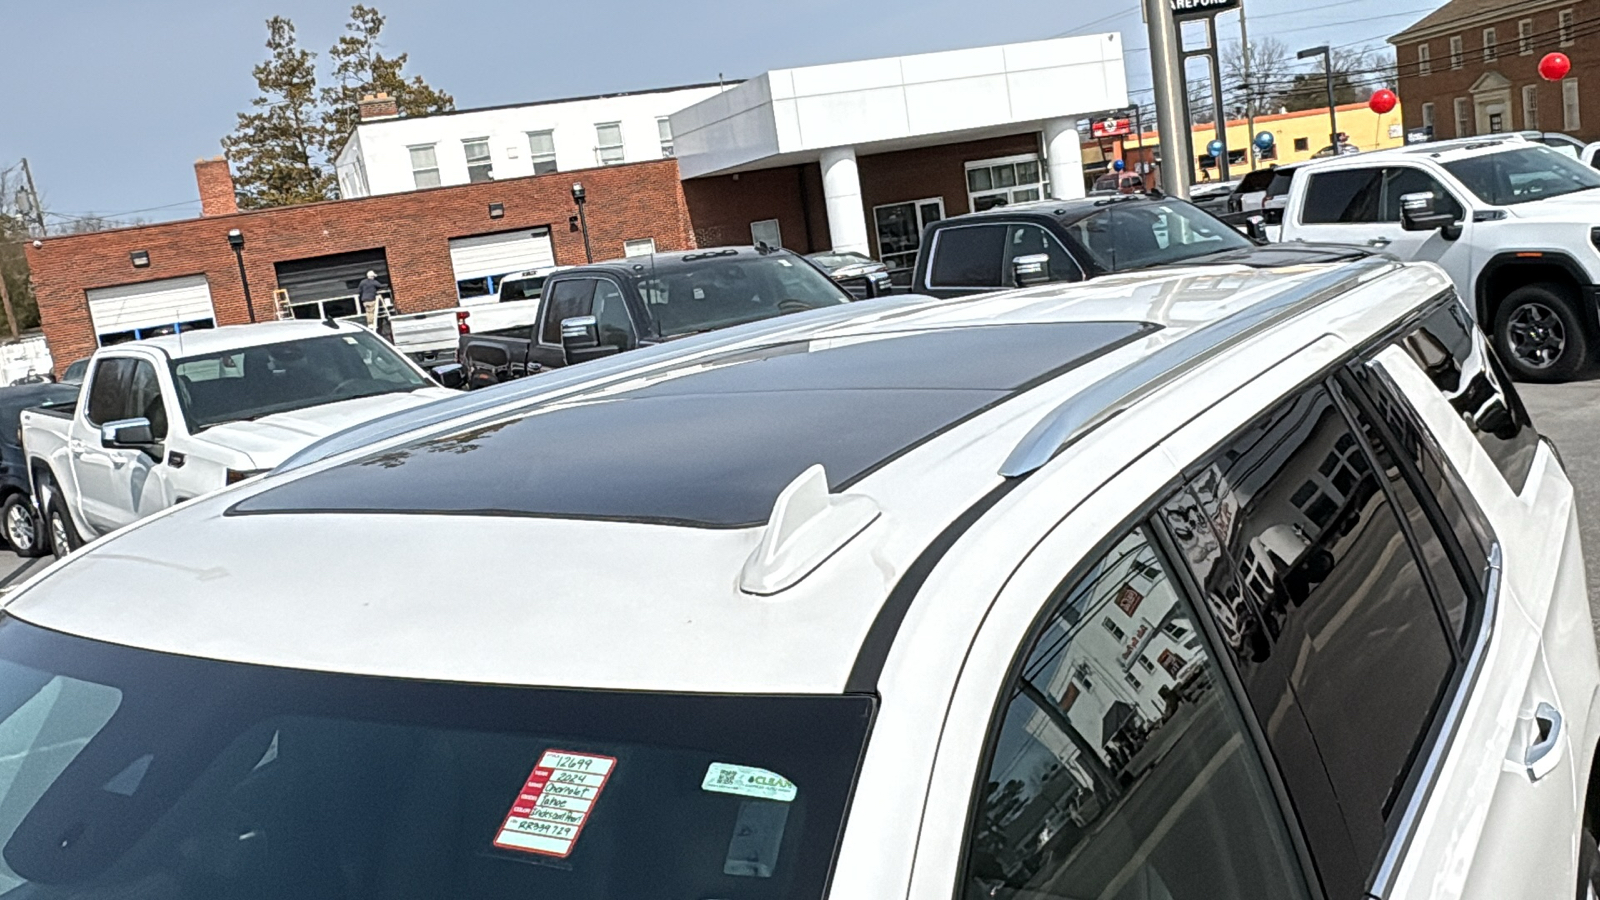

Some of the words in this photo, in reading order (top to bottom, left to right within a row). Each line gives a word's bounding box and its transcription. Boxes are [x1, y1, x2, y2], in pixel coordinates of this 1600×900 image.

[556, 756, 593, 770] 12699
[556, 772, 588, 784] 2024
[541, 793, 568, 808] Tahoe
